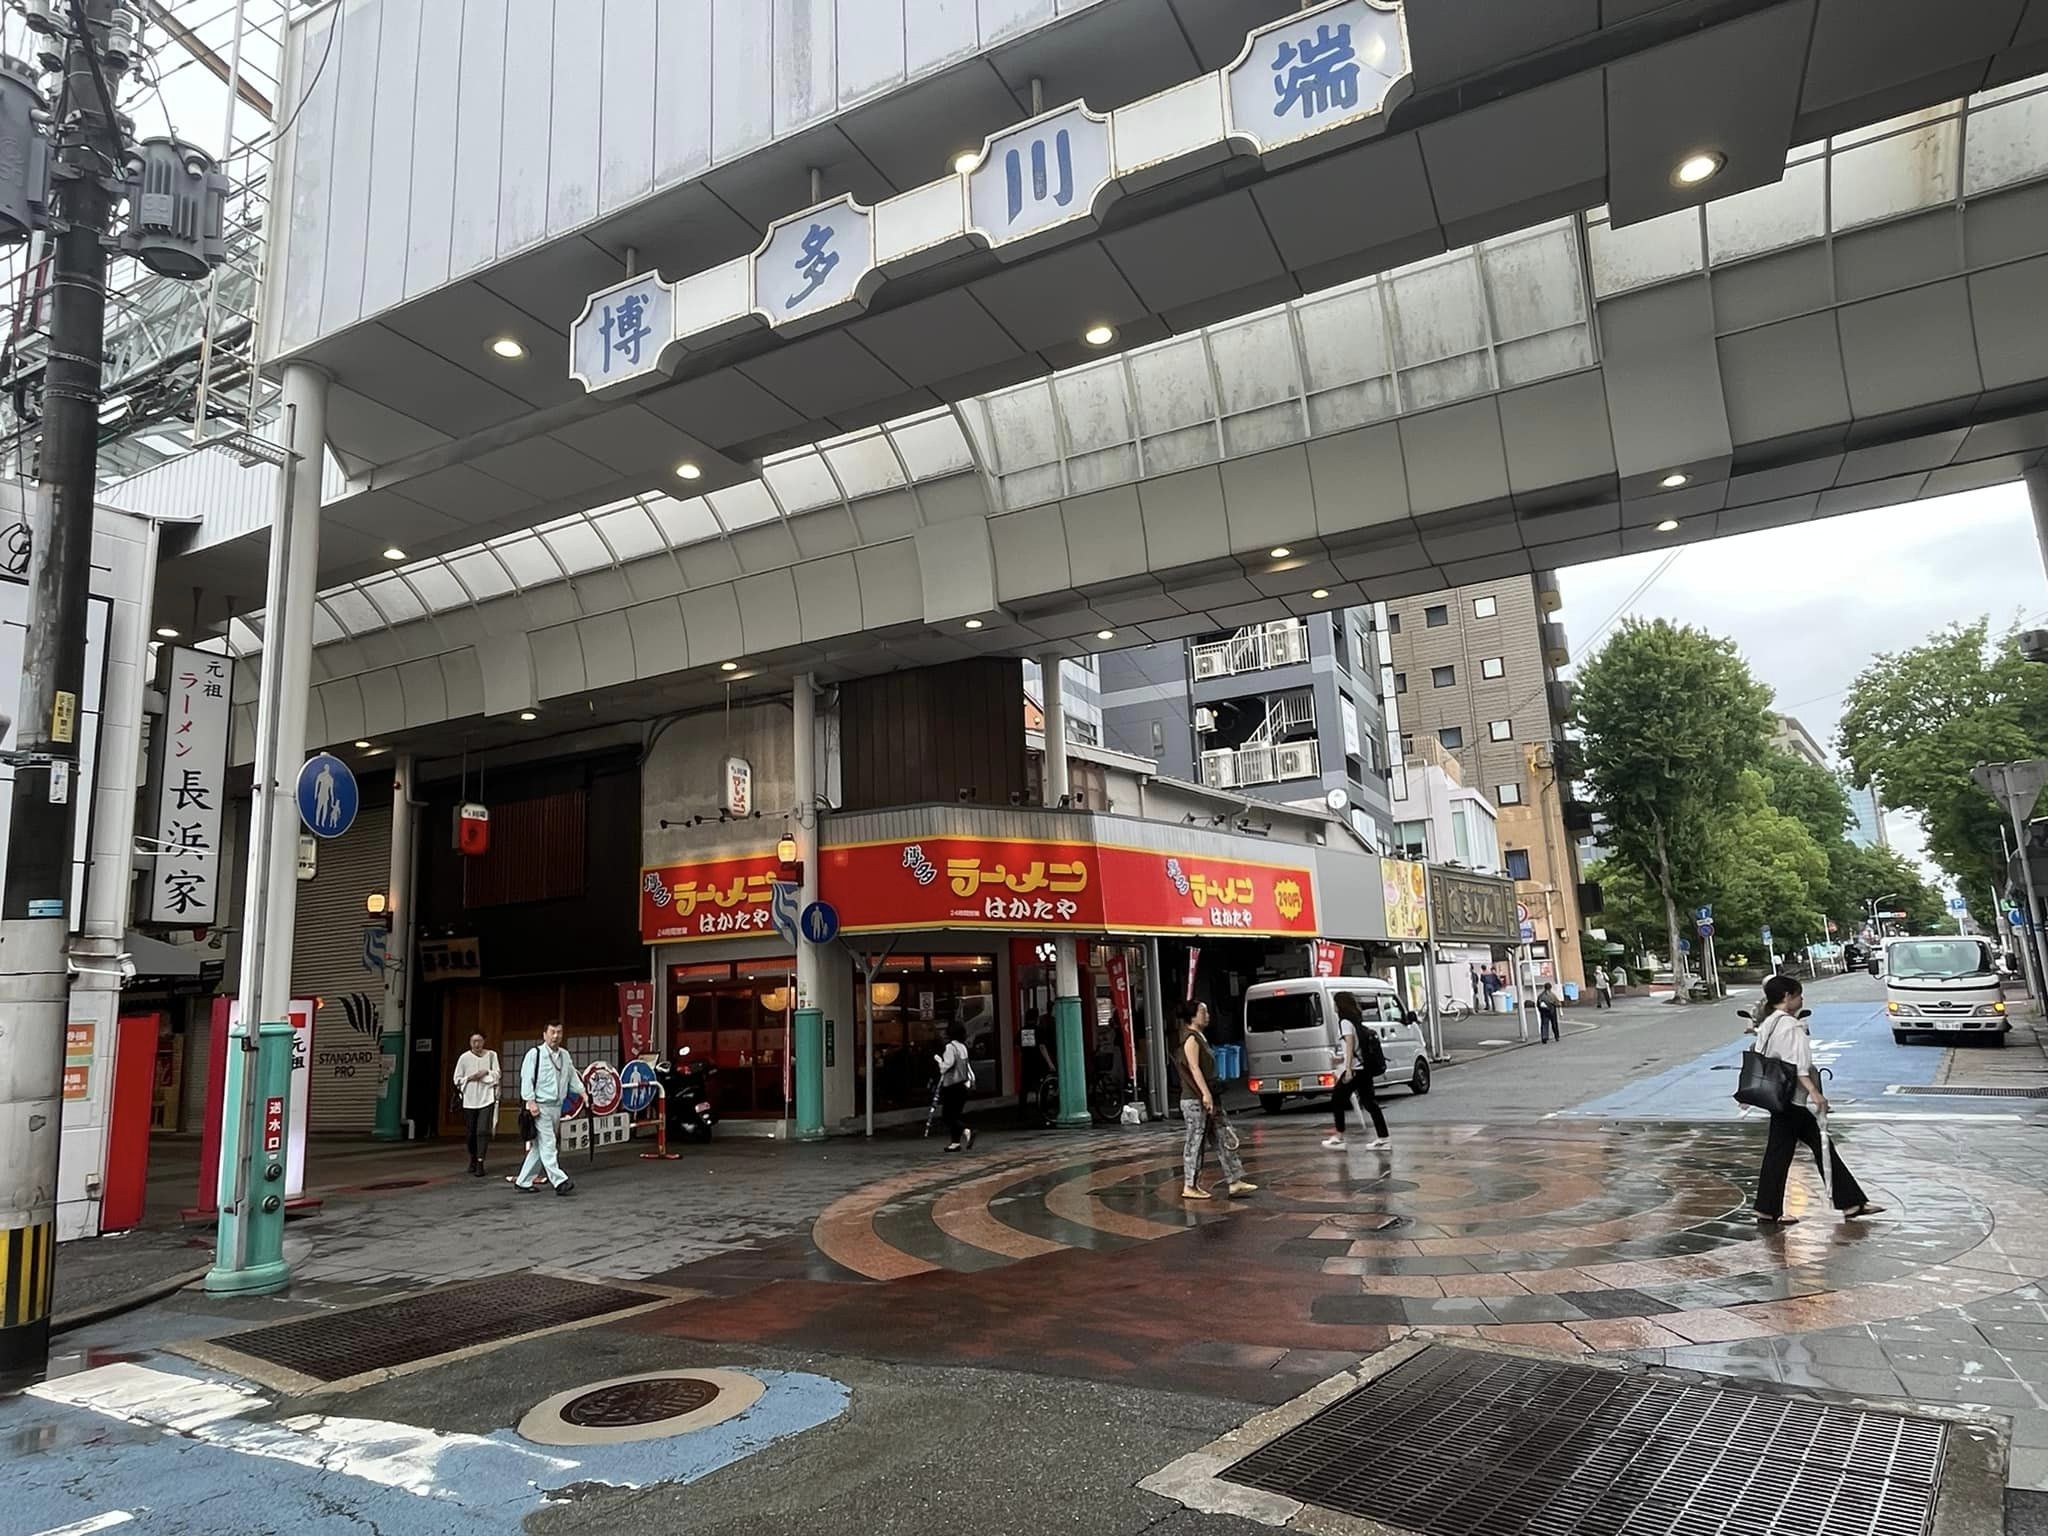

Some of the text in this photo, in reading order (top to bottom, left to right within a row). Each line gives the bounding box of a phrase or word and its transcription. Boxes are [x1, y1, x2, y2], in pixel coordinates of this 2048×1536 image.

[203, 661, 225, 698] 元祖
[175, 672, 198, 757] ラーメン
[164, 769, 213, 914] 長浜家
[903, 844, 937, 885] 博多
[947, 859, 1087, 897] ラーメン
[644, 872, 671, 907] 博多
[1189, 874, 1255, 908] ラーメン
[700, 909, 769, 933] はかたや
[985, 897, 1077, 920] はかたや
[1210, 907, 1253, 927] はかたや
[319, 1052, 373, 1065] STANDARD
[334, 1065, 356, 1078] PRO
[268, 1101, 281, 1149] 送水口
